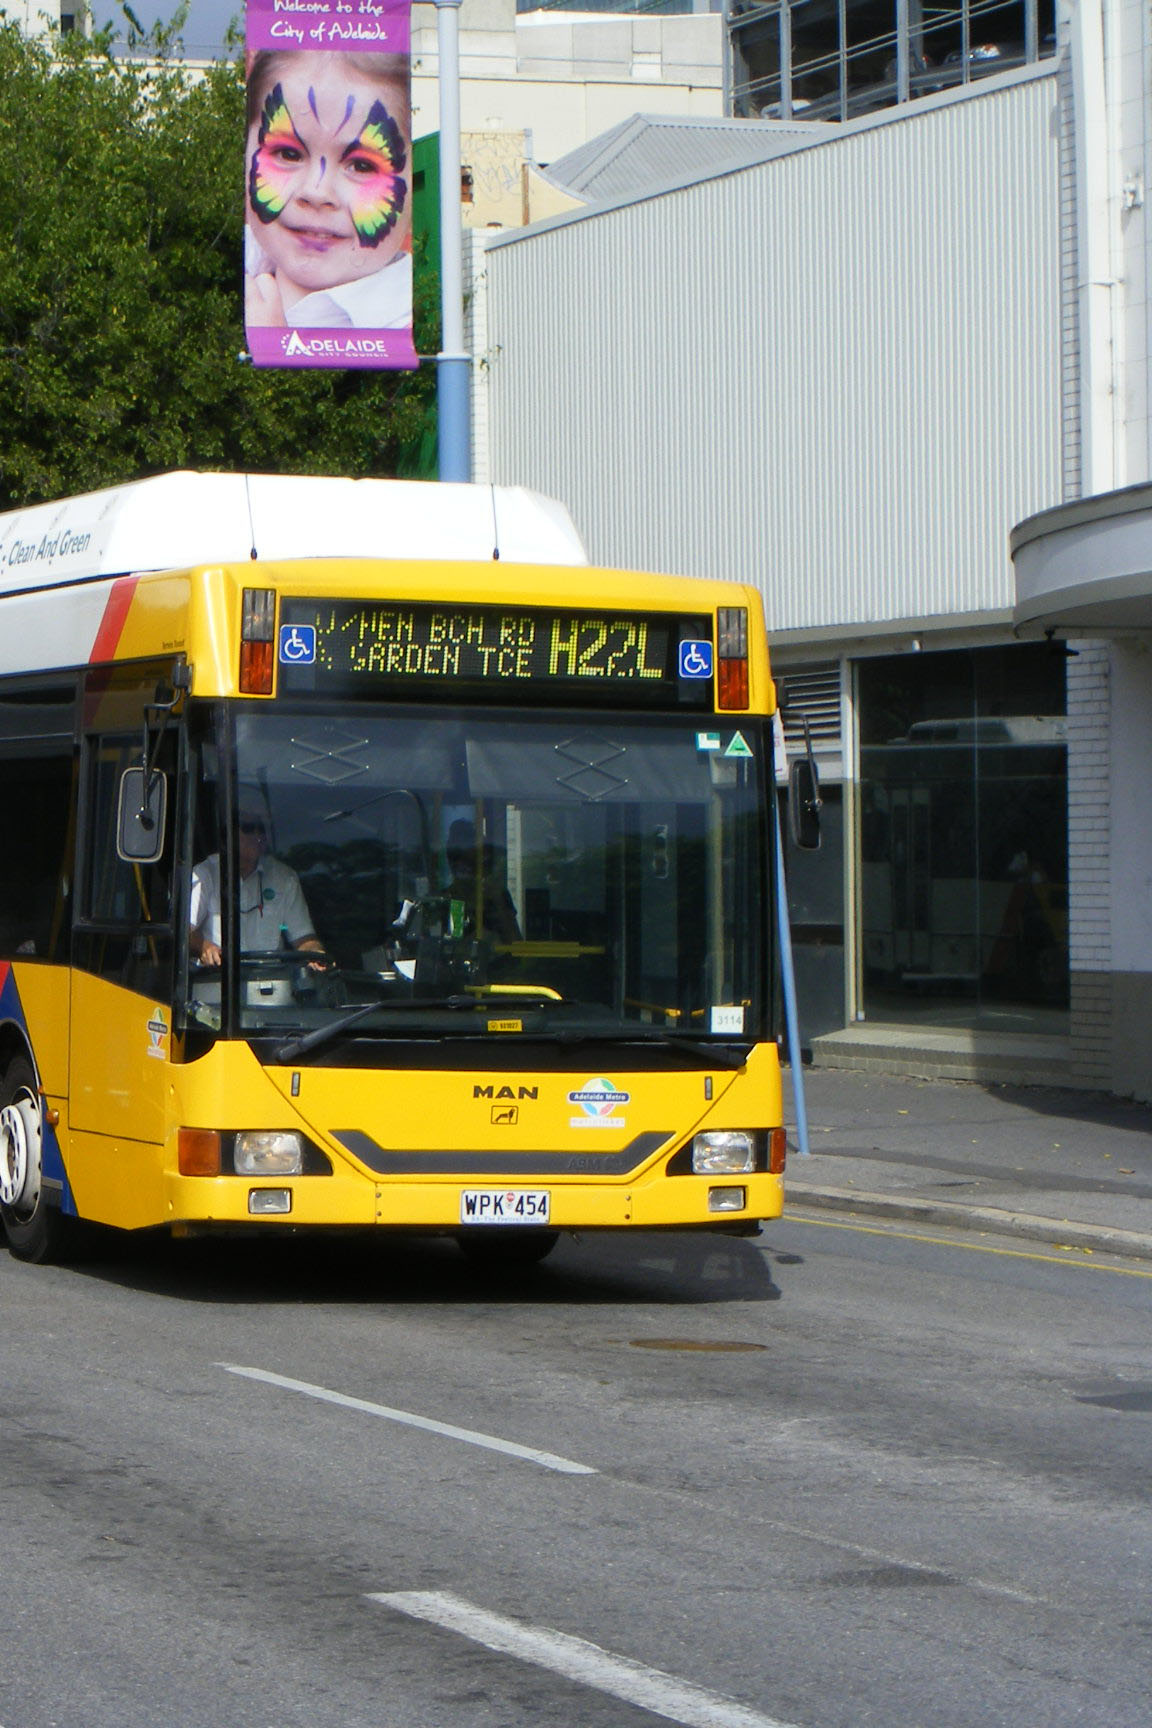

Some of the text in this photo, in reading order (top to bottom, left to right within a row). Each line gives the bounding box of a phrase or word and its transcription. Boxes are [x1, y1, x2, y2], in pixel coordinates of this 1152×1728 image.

[274, 0, 384, 16] Welcome to the
[270, 21, 388, 43] City of Adelaide
[284, 330, 386, 356] ADELAIDE
[8, 541, 35, 566] Clean
[37, 531, 60, 560] And
[59, 529, 91, 555] Green
[429, 613, 484, 645] BCH
[499, 616, 535, 646] RD
[548, 618, 662, 678] H22L
[477, 646, 534, 677] TCE
[717, 1015, 742, 1025] 3114
[473, 1085, 539, 1101] MAN
[465, 1194, 547, 1216] WPK 454
